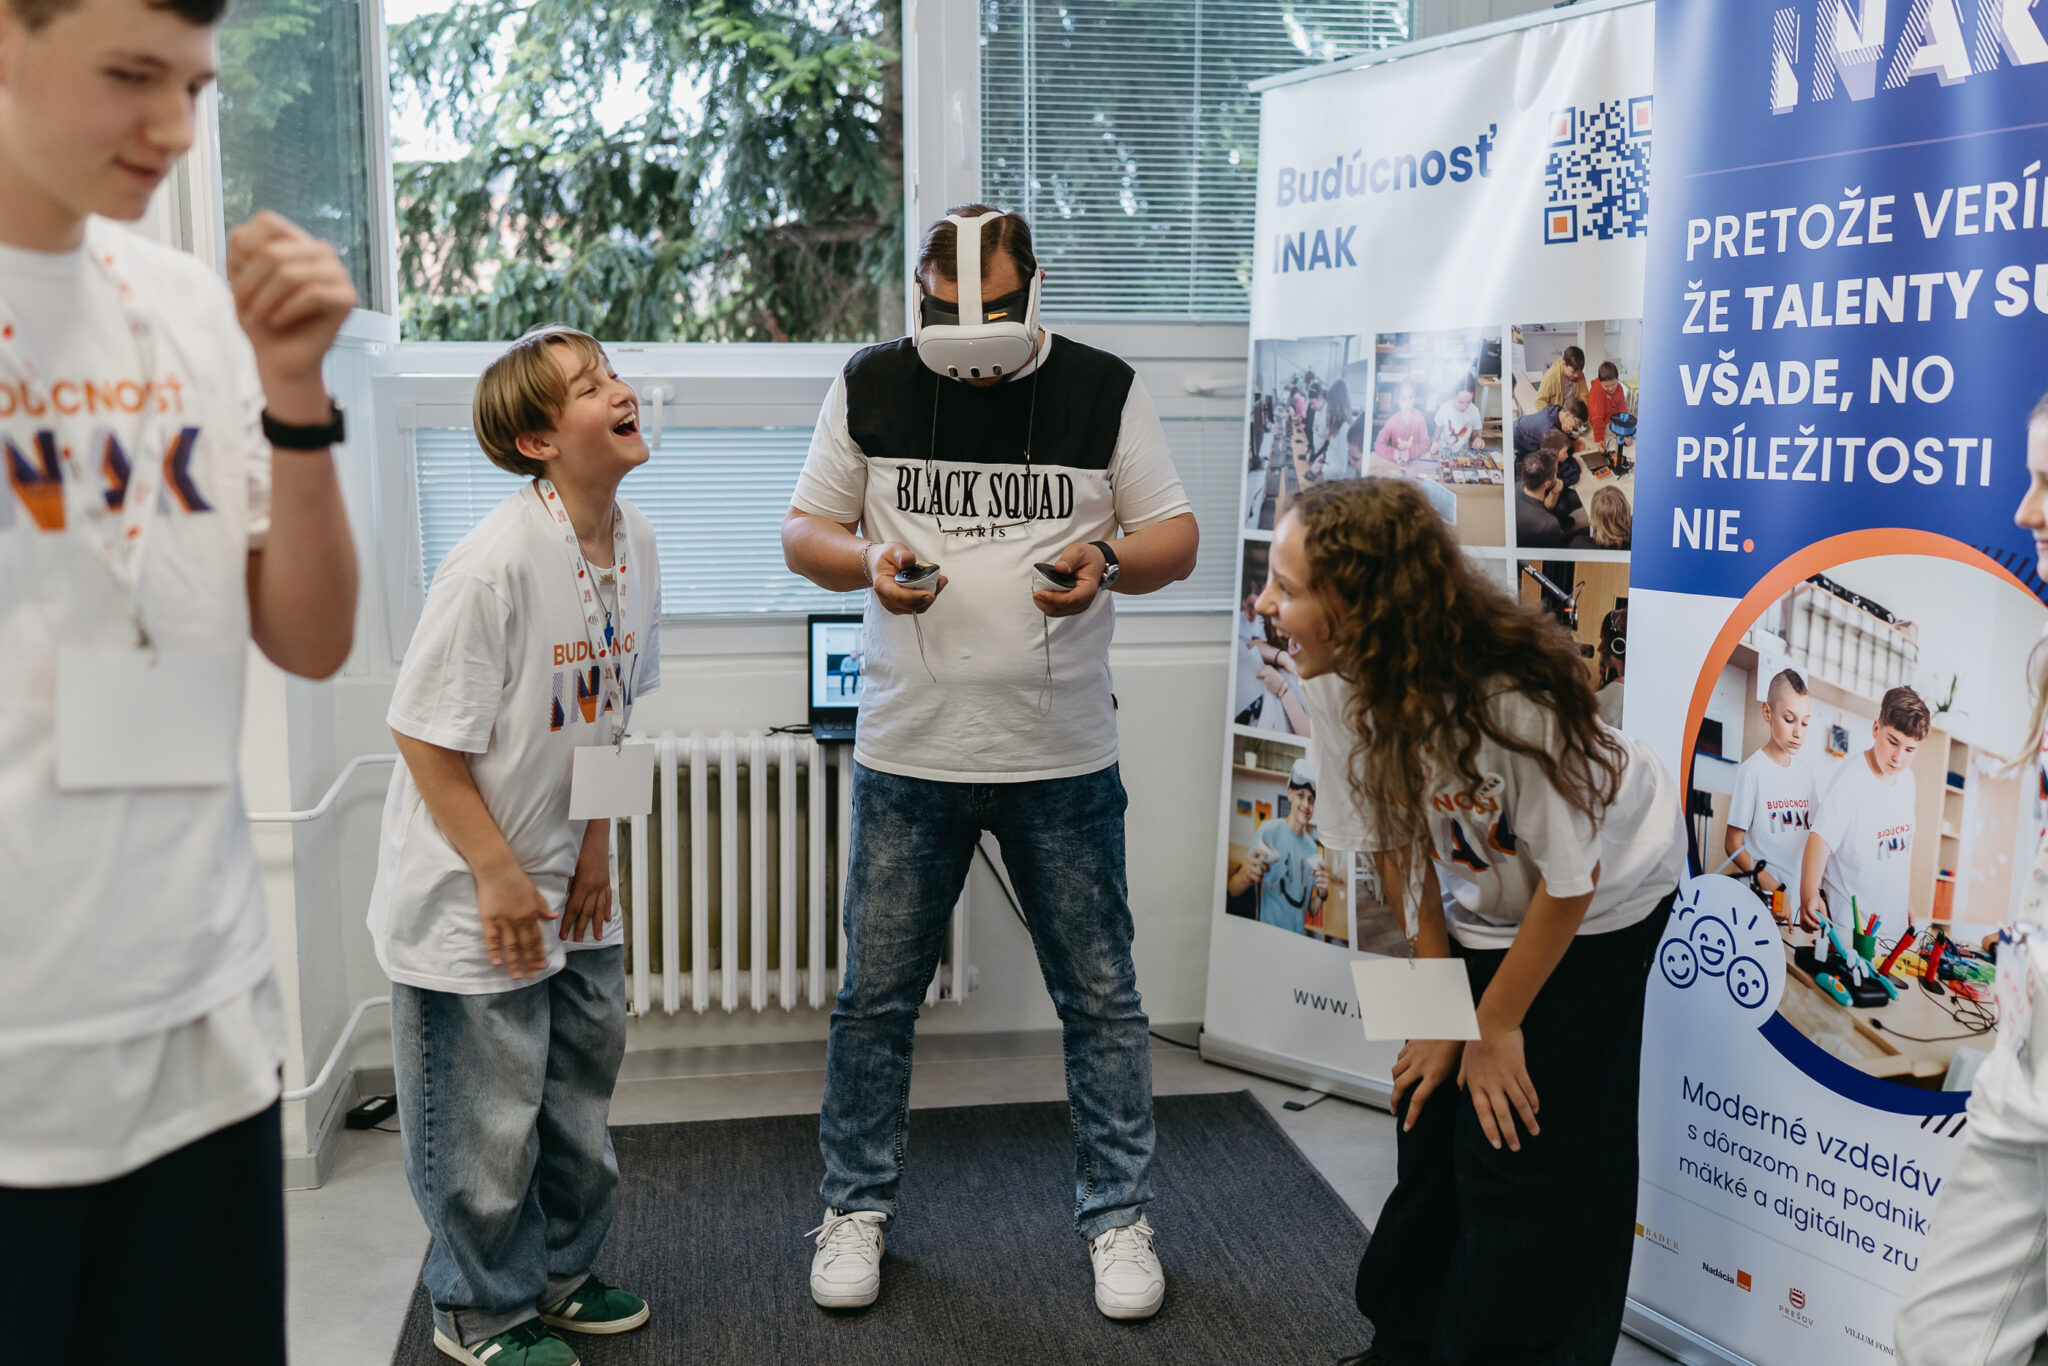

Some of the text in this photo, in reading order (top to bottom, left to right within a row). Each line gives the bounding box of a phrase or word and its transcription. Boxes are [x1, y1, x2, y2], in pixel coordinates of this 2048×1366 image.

[1276, 123, 1498, 208] Budúcnosť
[1687, 160, 2048, 262] PRETOŽE VERÍ
[1273, 225, 1358, 274] INAK
[1682, 279, 1731, 334] ŽE
[1744, 269, 1984, 331] TALENTY
[1678, 348, 1955, 412] VŠADE, NO
[1675, 422, 1993, 487] PRÍLEŽITOSTI
[896, 466, 1074, 520] BLACK SQUAD
[1672, 507, 1755, 553] NIE.
[1682, 1075, 1946, 1198] Moderné vzdeláv
[1687, 1124, 1932, 1237] s dôrazom na podnik
[1679, 1156, 1919, 1272] mäkké a digitálne zru
[1702, 1262, 1735, 1285] Nadácia
[1778, 1304, 1814, 1326] PREŠOV
